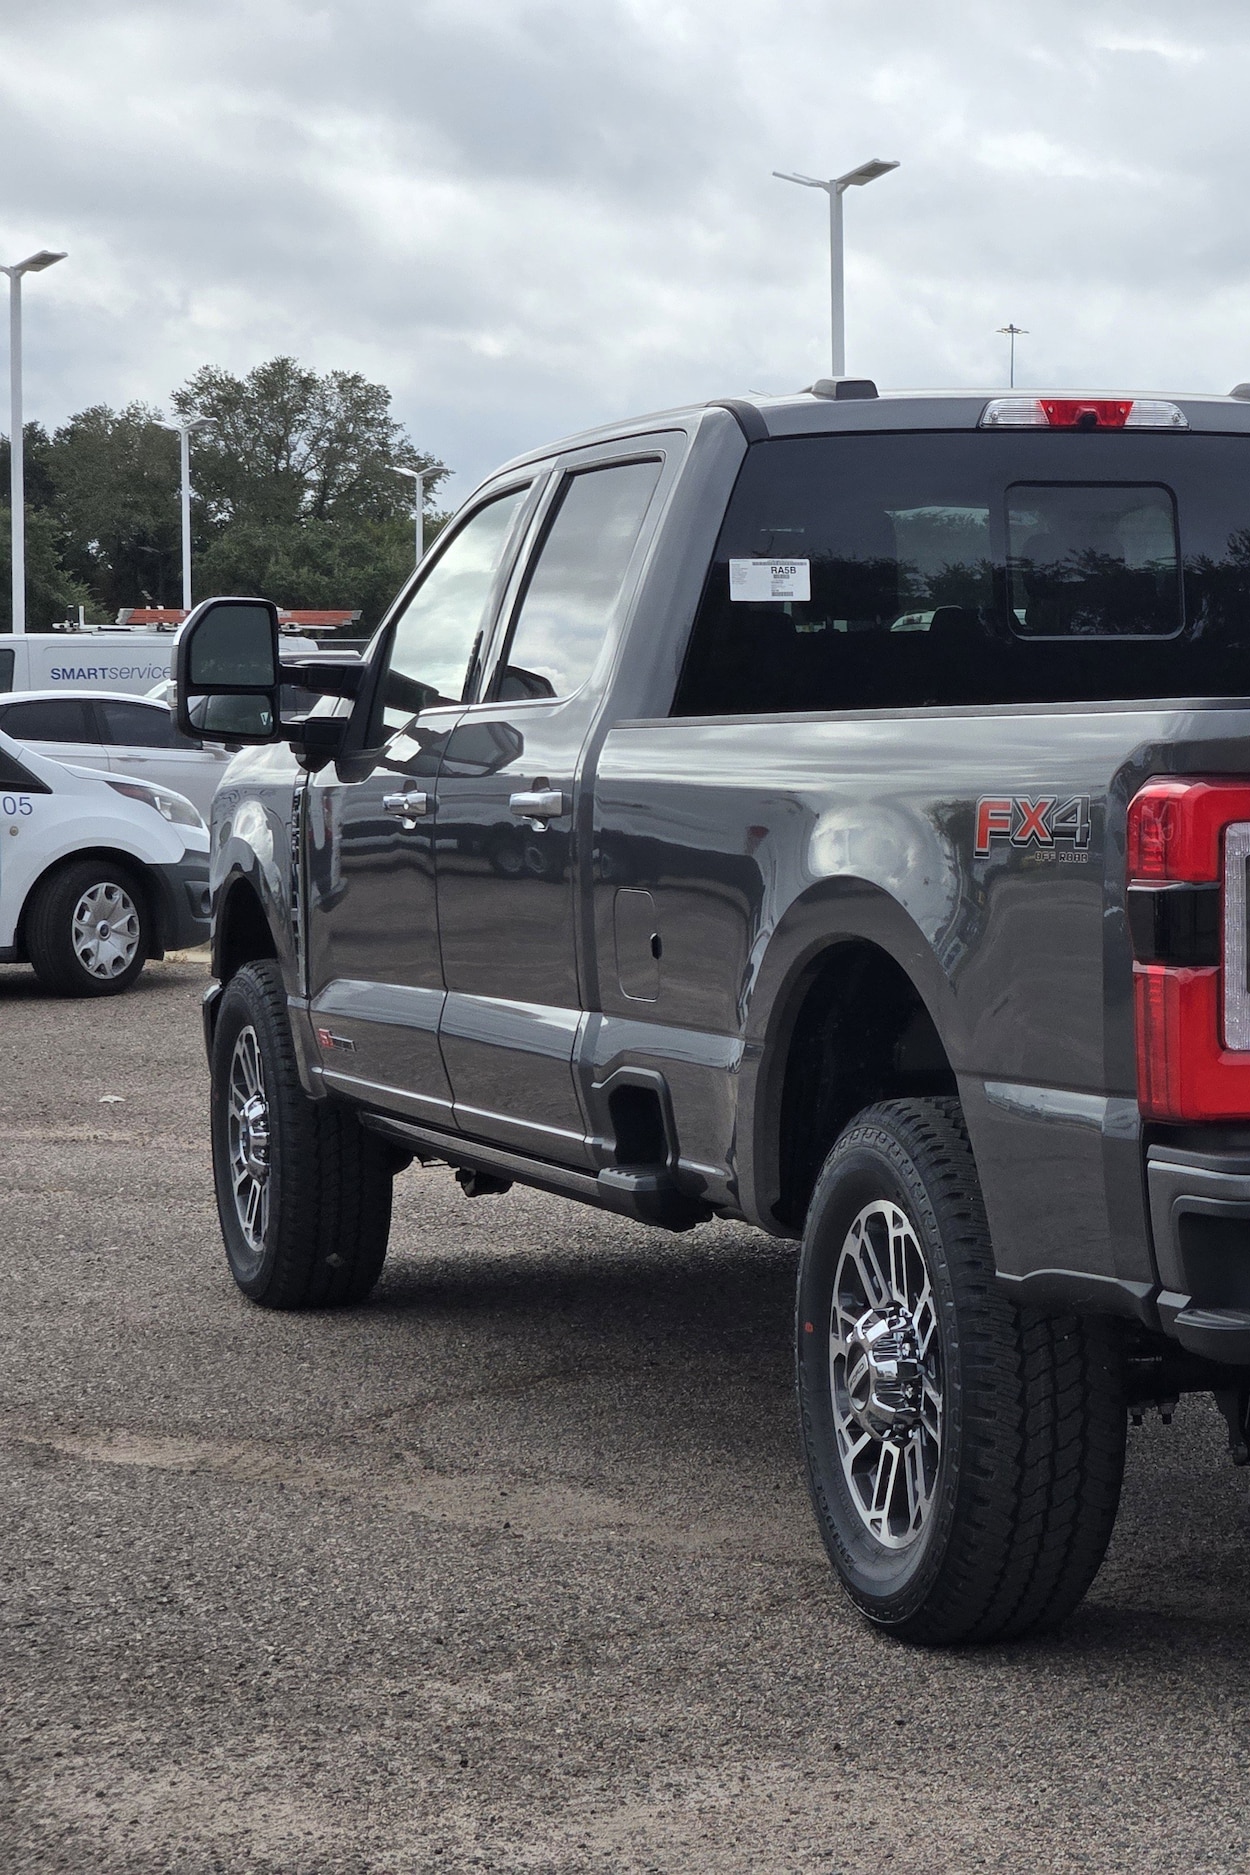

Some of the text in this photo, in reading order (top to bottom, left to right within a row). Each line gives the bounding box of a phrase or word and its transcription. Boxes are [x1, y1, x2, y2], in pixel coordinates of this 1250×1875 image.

[2, 796, 33, 816] 05
[973, 793, 1092, 859] FX4
[1034, 851, 1089, 863] OFF ROAD
